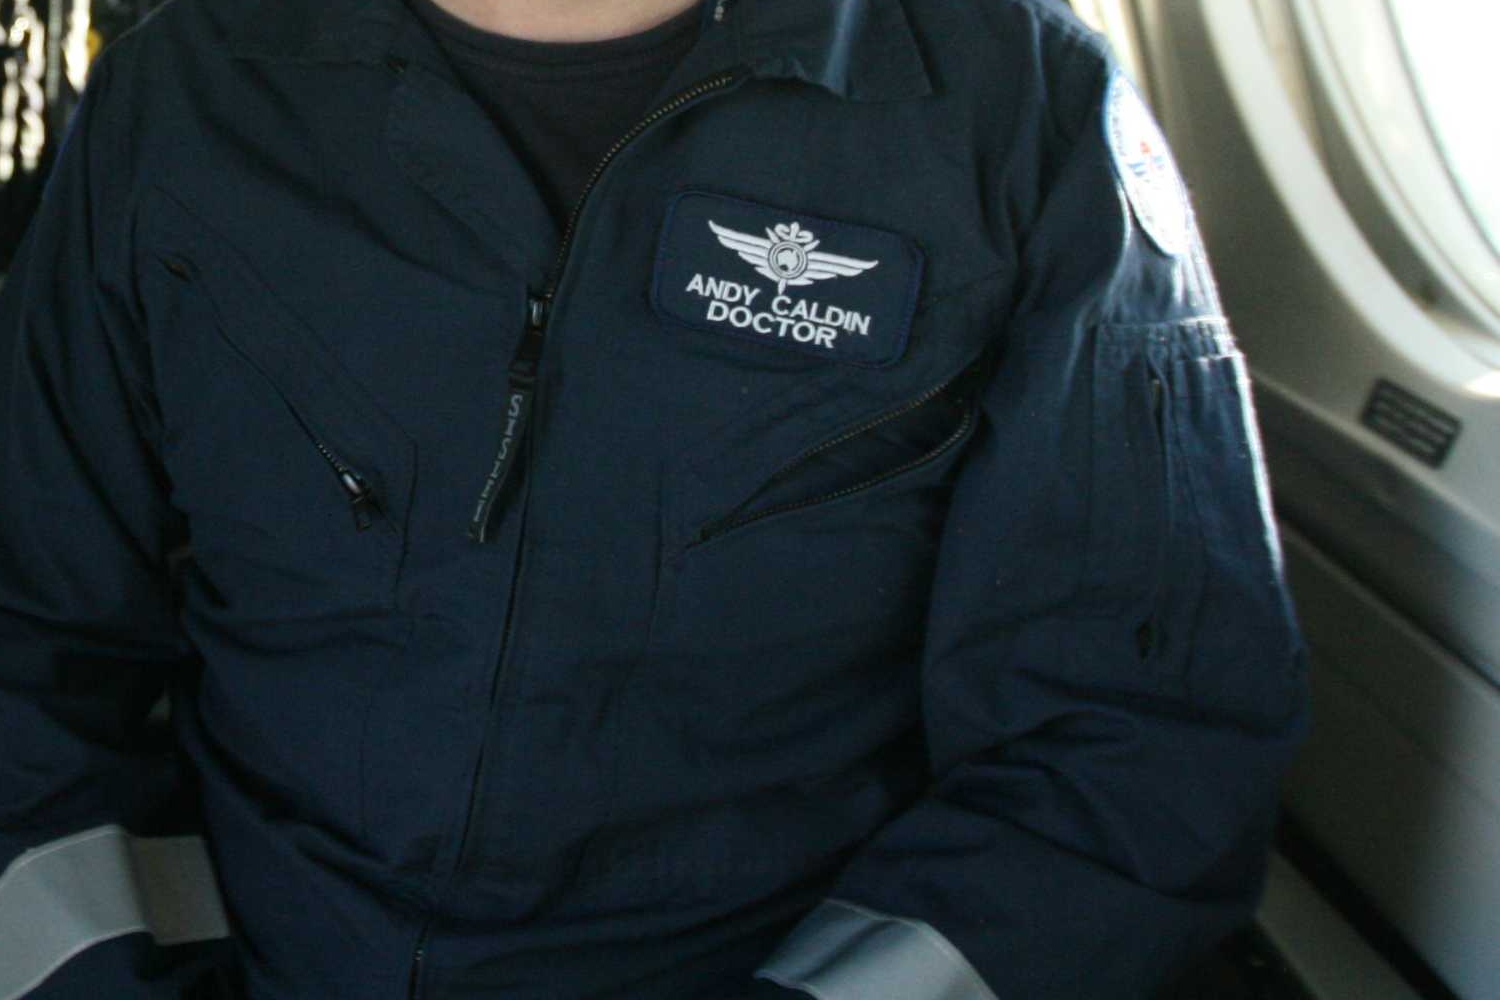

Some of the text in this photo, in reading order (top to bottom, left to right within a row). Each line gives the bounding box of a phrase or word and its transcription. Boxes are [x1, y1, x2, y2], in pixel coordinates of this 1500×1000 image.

[685, 273, 871, 336] ANDY CALDIN
[706, 300, 837, 349] DOCTOR
